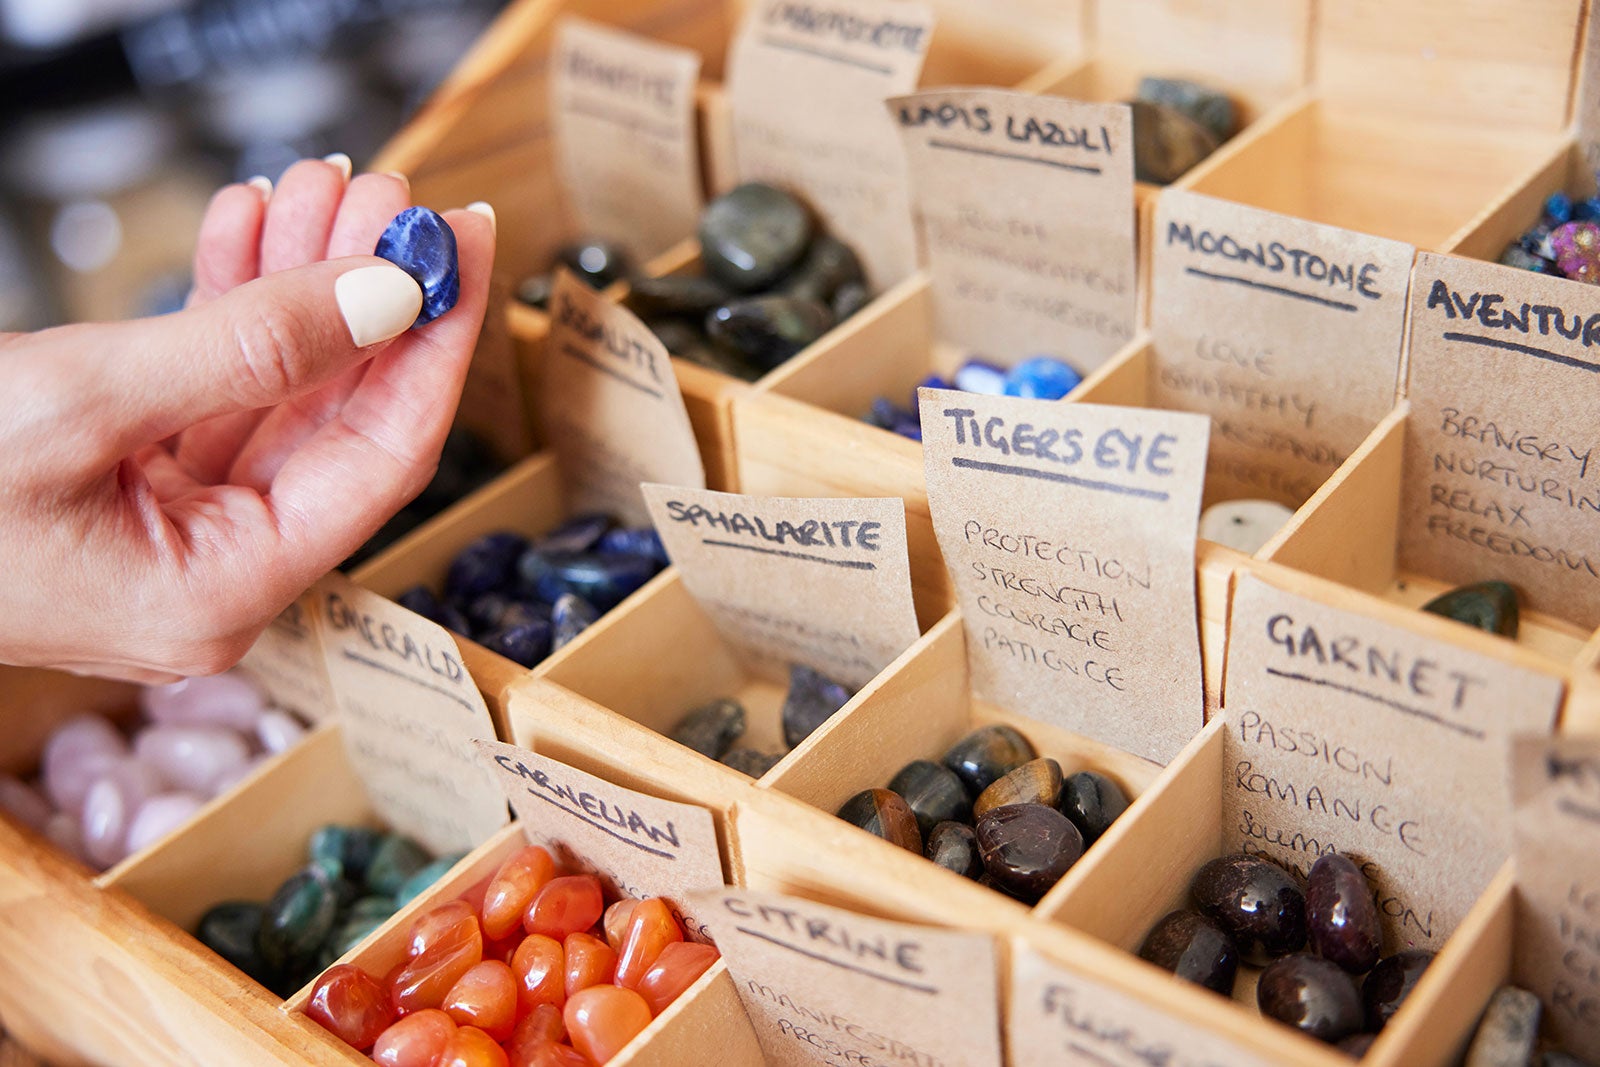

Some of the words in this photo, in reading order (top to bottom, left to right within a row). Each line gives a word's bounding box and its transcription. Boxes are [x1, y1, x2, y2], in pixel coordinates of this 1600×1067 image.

[901, 104, 992, 133] LAPIS
[1007, 116, 1112, 155] LAZULI
[1167, 221, 1382, 300] MOONSTONE
[1427, 279, 1600, 348] AVENTUR
[1194, 333, 1276, 377] LOVE
[944, 408, 1083, 465] TIGERS
[1094, 428, 1178, 477] EYE
[1440, 407, 1592, 479] BRAVERY
[667, 501, 882, 552] SPHALARITE
[1430, 484, 1532, 528] RELAX
[964, 520, 1150, 589] PROTECTION
[1428, 515, 1599, 577] FREEDOM
[972, 562, 1123, 623] STRENGTH
[977, 596, 1111, 651] COURAGE
[327, 594, 463, 682] EMERALD
[984, 627, 1125, 692] PATIENCE
[1267, 614, 1490, 710] GARNET
[1240, 711, 1394, 787] PASSION
[495, 754, 680, 848] CARNELIAN
[1234, 761, 1427, 857] ROMANCE
[724, 898, 924, 973] CITRINE
